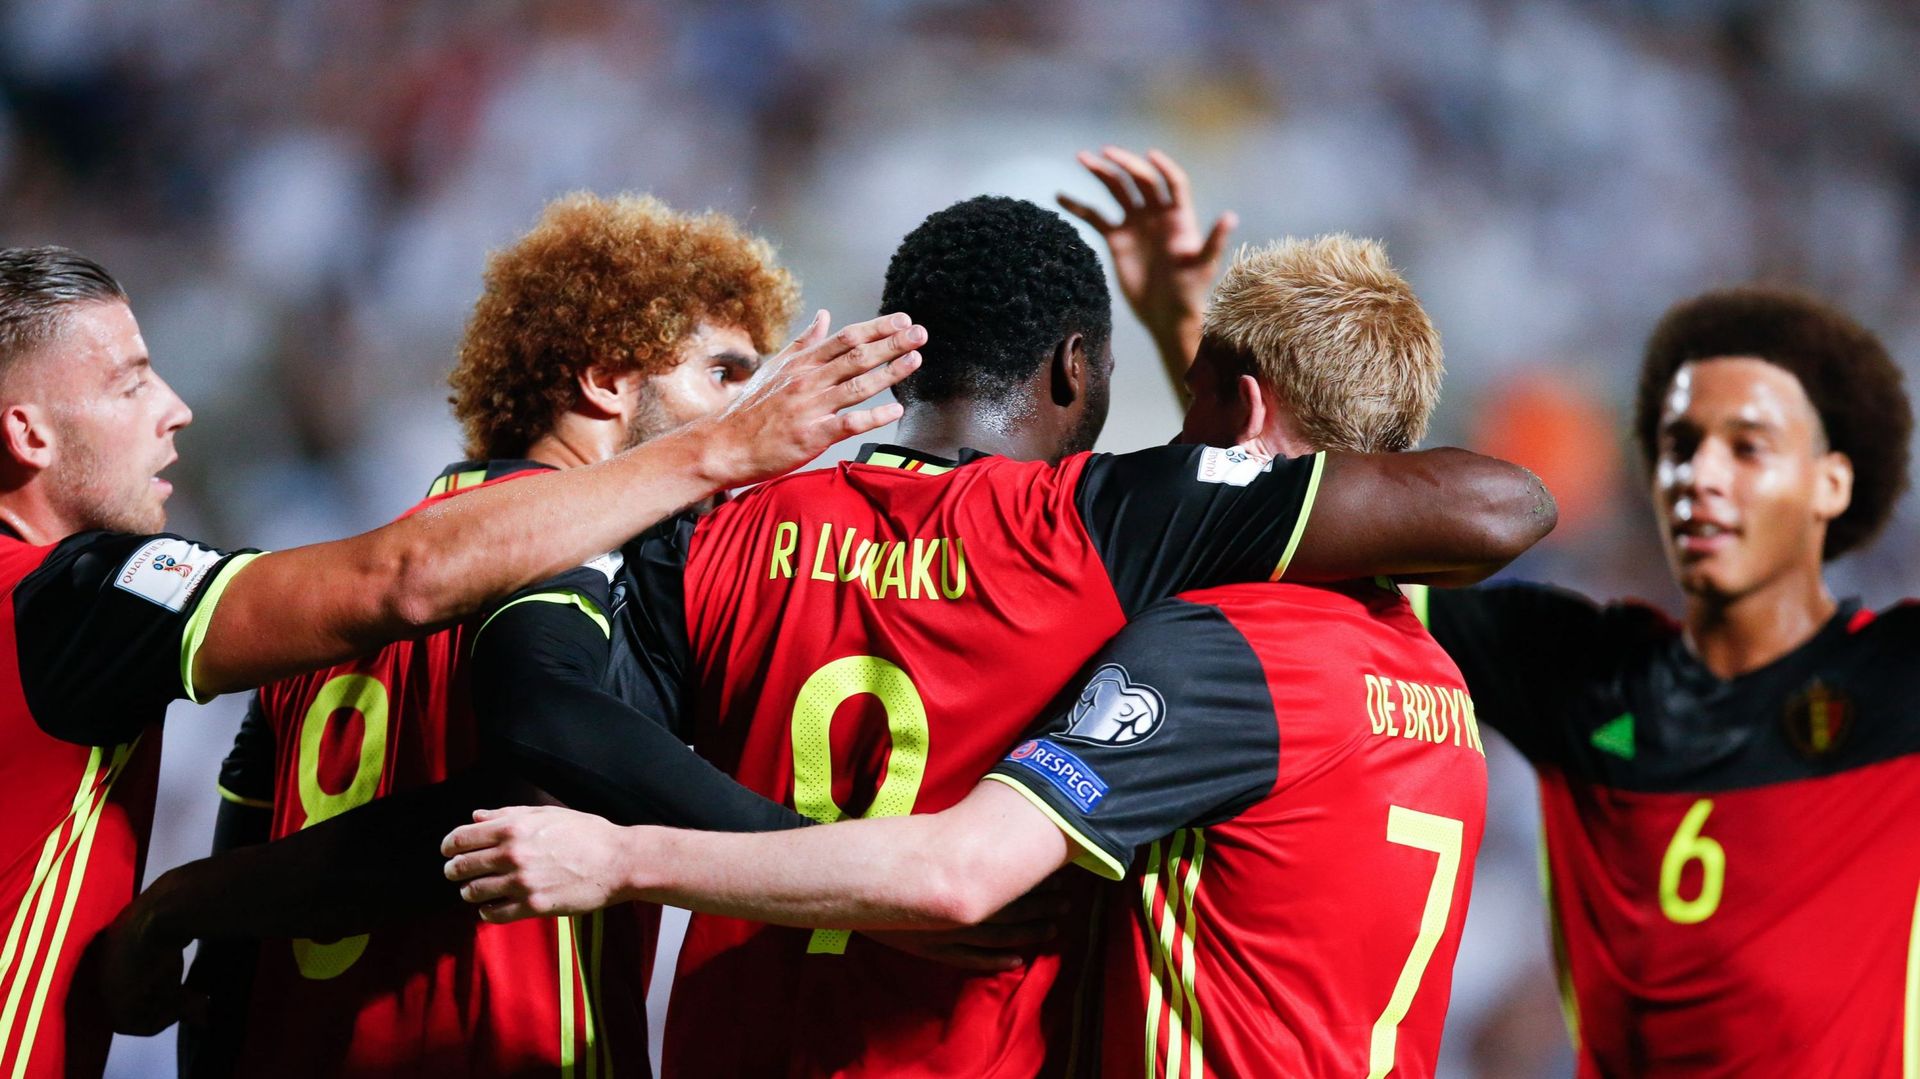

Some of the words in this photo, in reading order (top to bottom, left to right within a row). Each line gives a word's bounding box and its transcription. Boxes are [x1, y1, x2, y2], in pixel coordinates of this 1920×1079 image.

[811, 522, 967, 600] LUKAKU
[1364, 673, 1399, 737] DE
[1396, 680, 1486, 758] BRUYN
[790, 655, 930, 955] 9
[1030, 747, 1103, 805] RESPECT
[1658, 798, 1726, 925] 6
[1366, 804, 1464, 1079] 7
